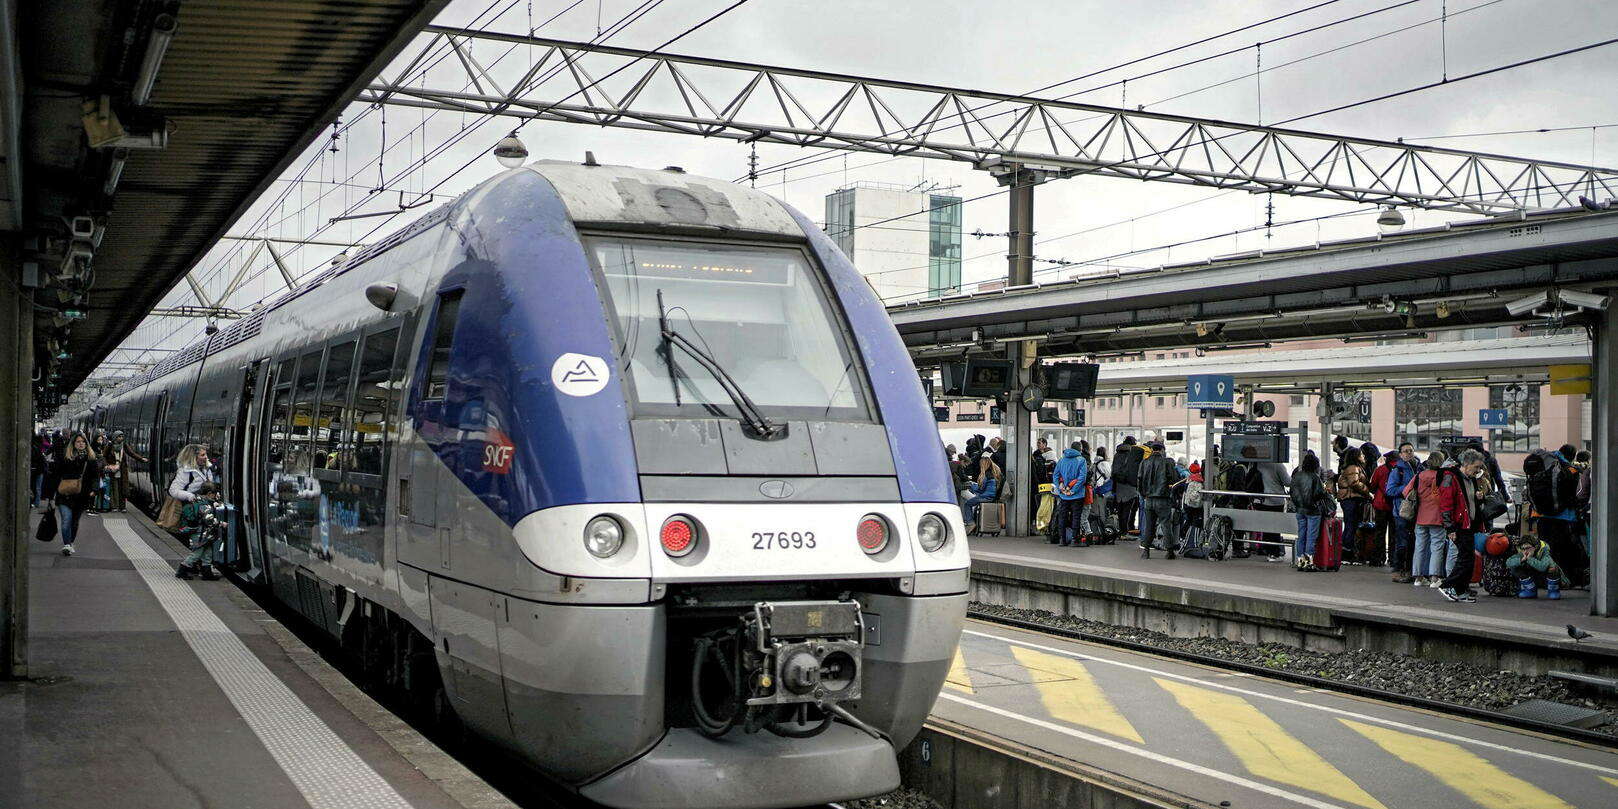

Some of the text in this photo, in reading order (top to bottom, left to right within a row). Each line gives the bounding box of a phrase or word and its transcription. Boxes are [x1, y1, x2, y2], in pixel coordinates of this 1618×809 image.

[483, 444, 513, 467] SNCF
[751, 531, 817, 550] 27693
[921, 740, 930, 761] 6
